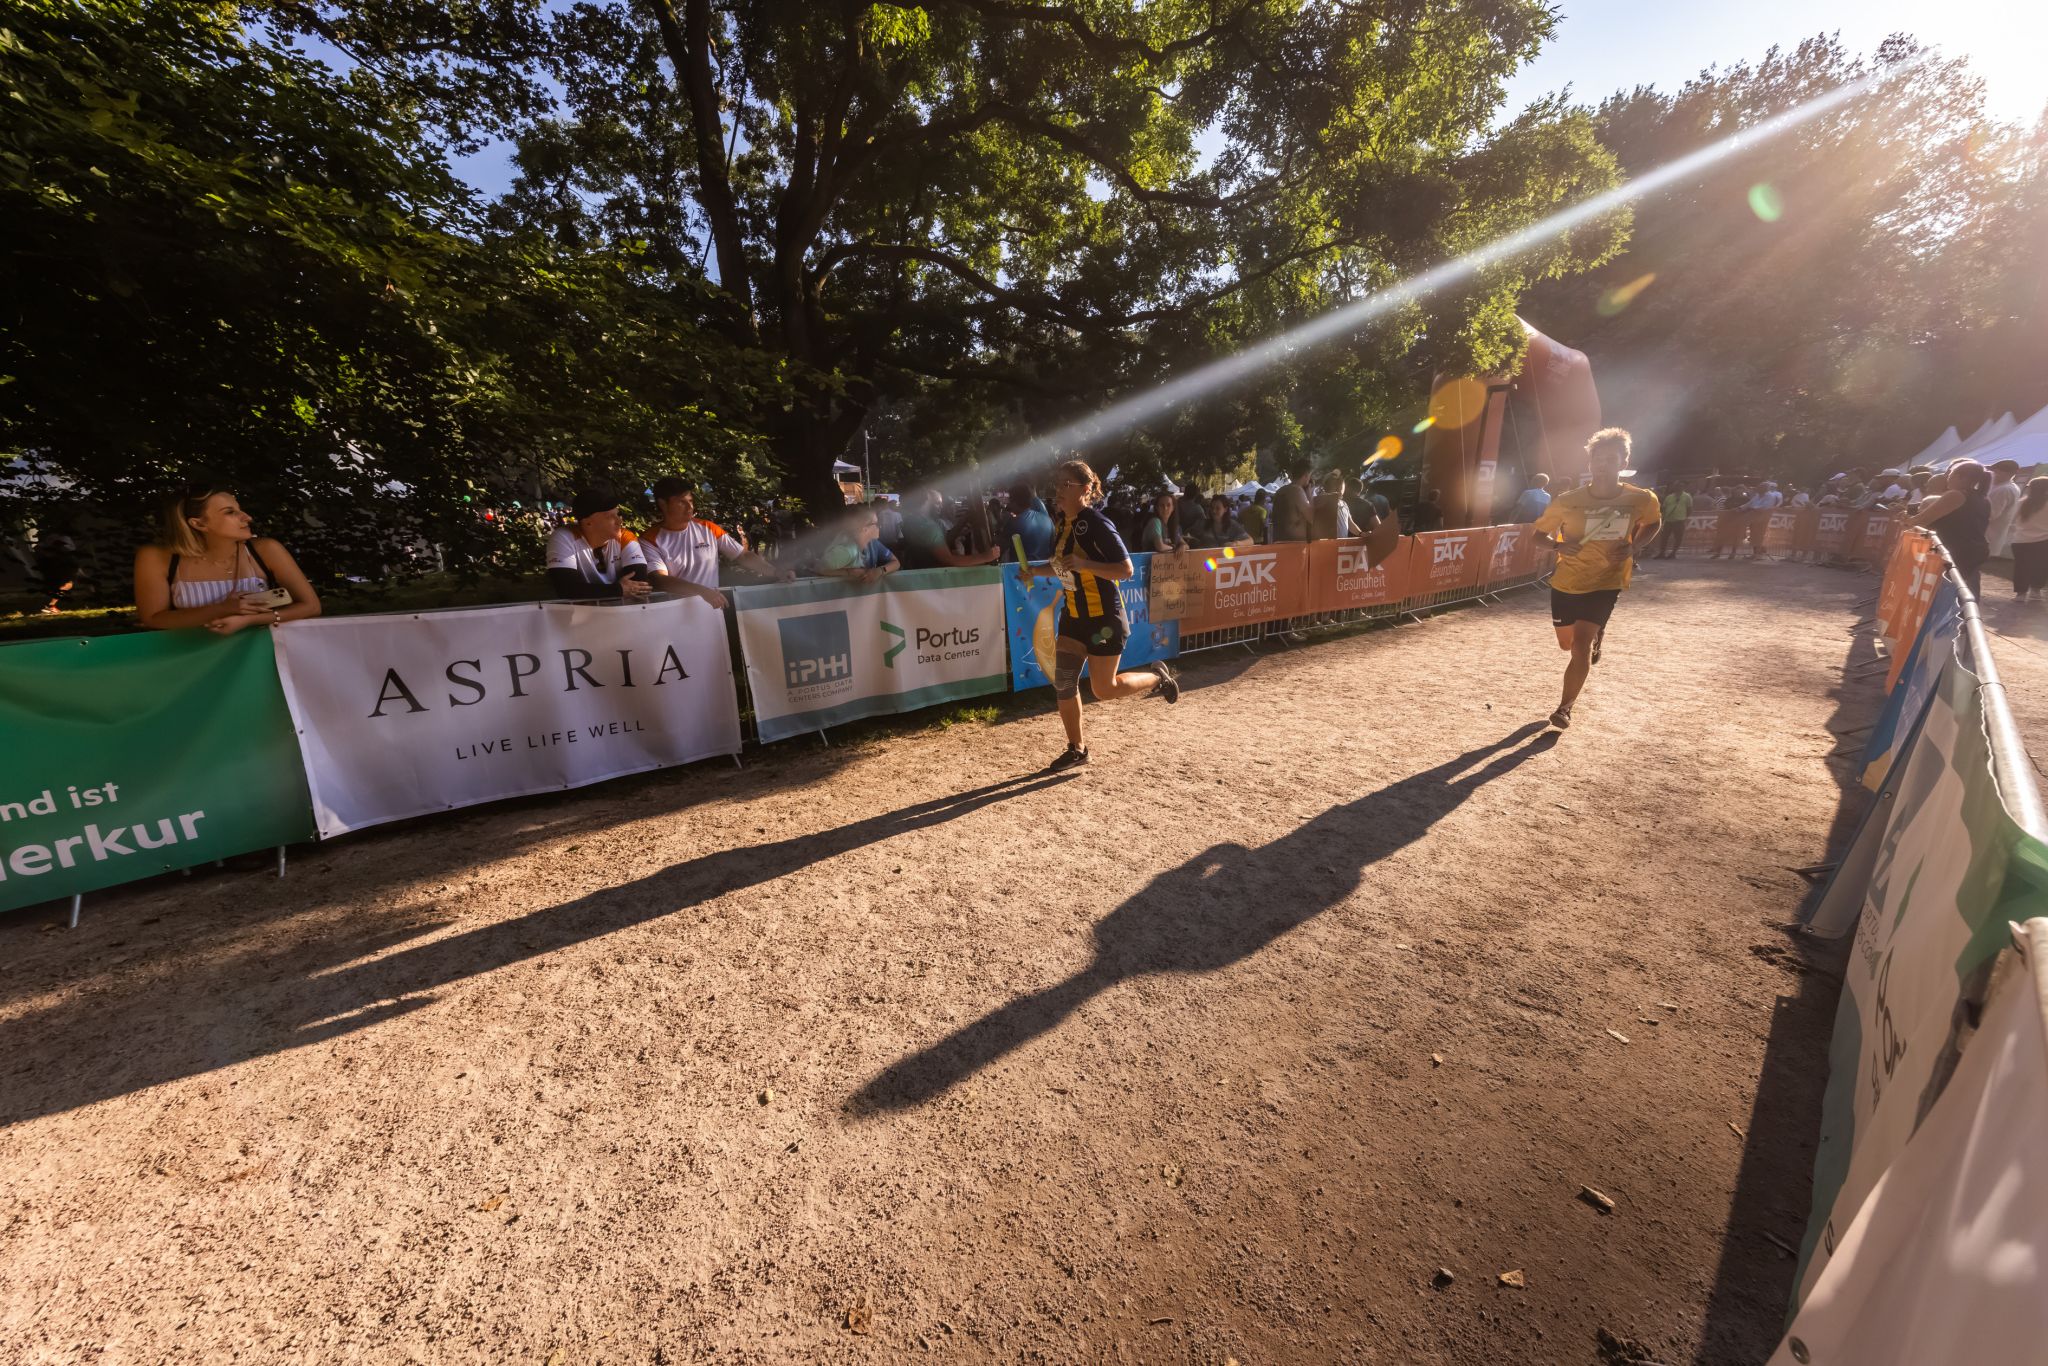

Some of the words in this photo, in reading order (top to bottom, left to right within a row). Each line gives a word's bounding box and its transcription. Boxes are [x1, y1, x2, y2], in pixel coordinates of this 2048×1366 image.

[1433, 536, 1469, 564] DAK
[1215, 553, 1278, 590] DAK
[1336, 573, 1386, 592] Gesundheit
[1215, 584, 1278, 609] Gesundheit
[916, 627, 979, 650] Portus
[918, 654, 942, 665] Data
[944, 649, 980, 661] Centers
[367, 645, 691, 718] ASPRIA
[798, 683, 831, 695] PORTUS
[456, 738, 513, 760] LIVE
[527, 730, 578, 749] LIFE
[588, 720, 646, 741] WELL
[67, 782, 120, 809] ist
